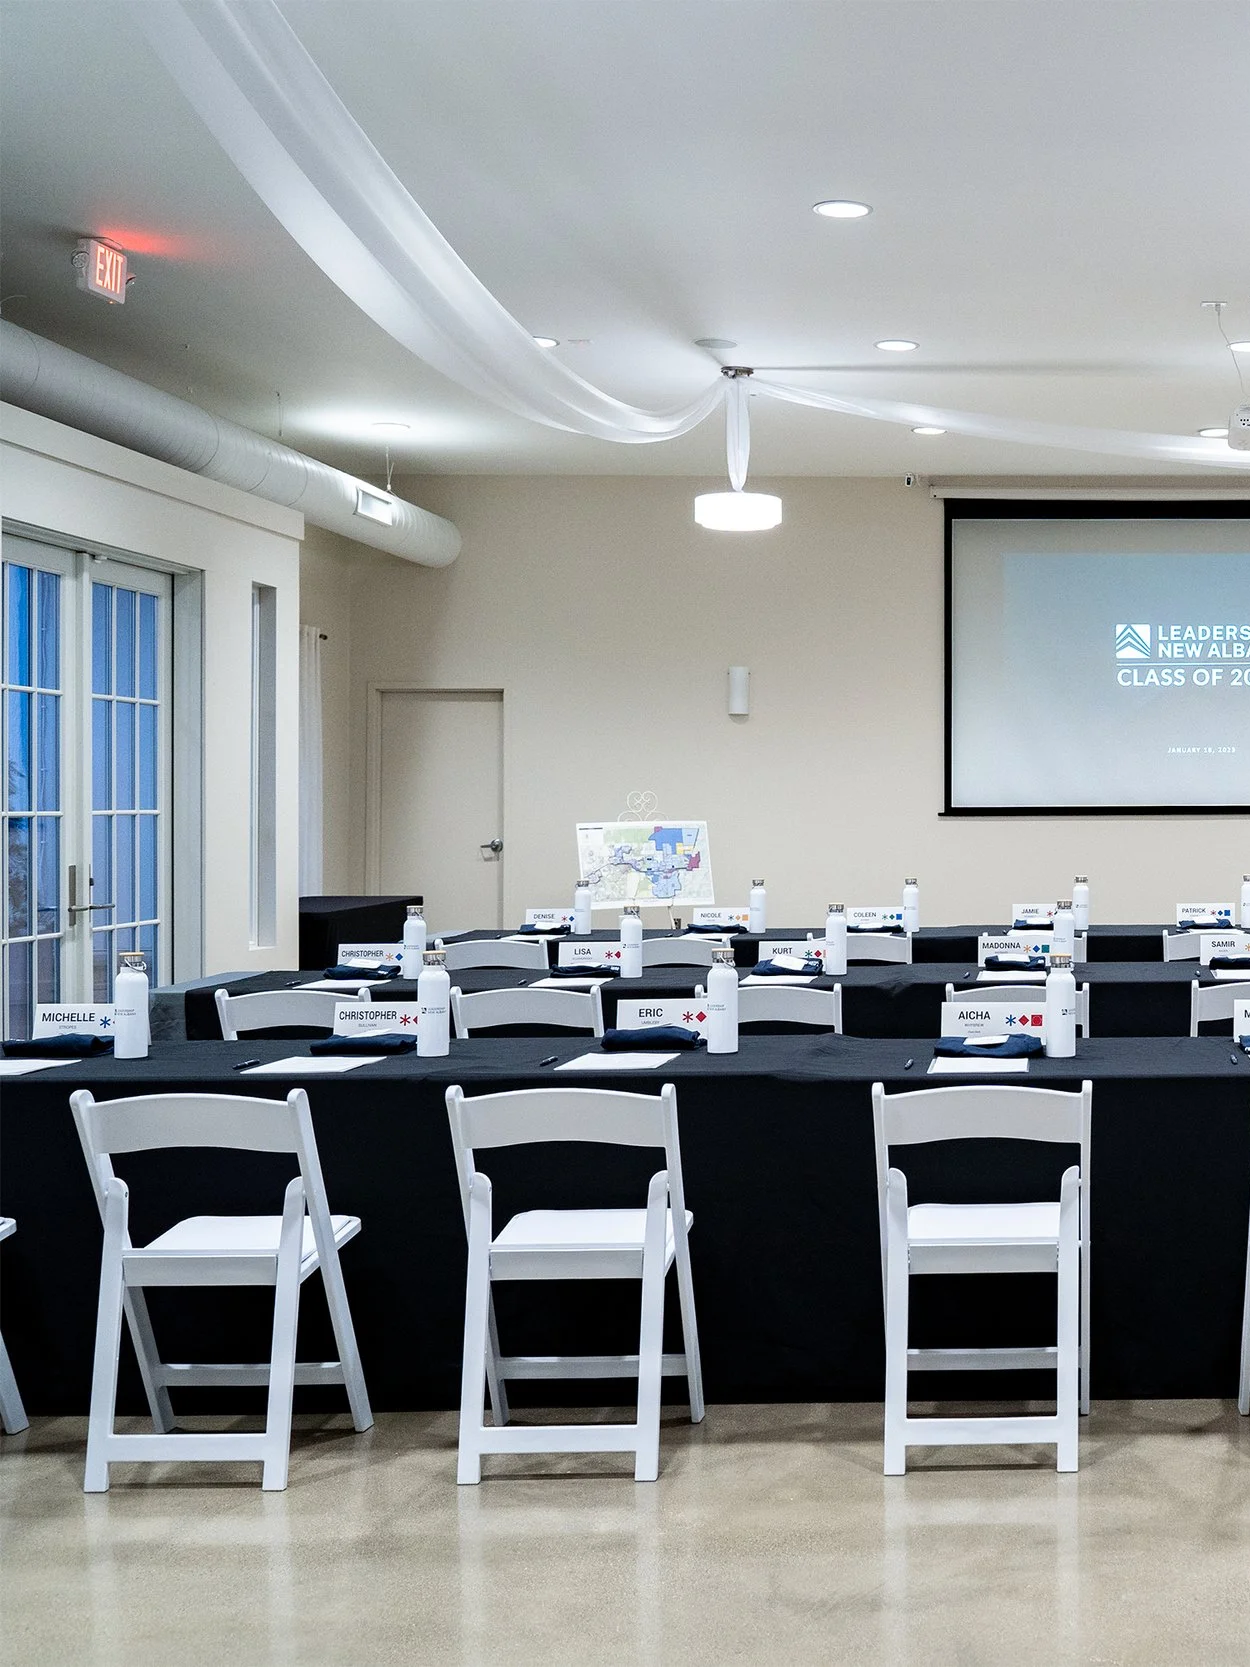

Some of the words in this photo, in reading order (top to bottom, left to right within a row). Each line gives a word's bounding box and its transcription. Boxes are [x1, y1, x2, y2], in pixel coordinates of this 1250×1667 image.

[95, 245, 124, 294] EXIT
[1158, 642, 1204, 658] NEW
[1117, 668, 1186, 686] CLASS
[1192, 668, 1224, 686] OF
[1211, 940, 1236, 948] SAMIR
[341, 950, 384, 958] CHRISTOPHER
[574, 948, 592, 956] LISA
[772, 947, 793, 955] KURT
[41, 1012, 96, 1022] MICHELLE
[339, 1010, 397, 1020] CHRISTOPHER
[638, 1008, 664, 1018] ERIC
[958, 1011, 991, 1020] AICHA
